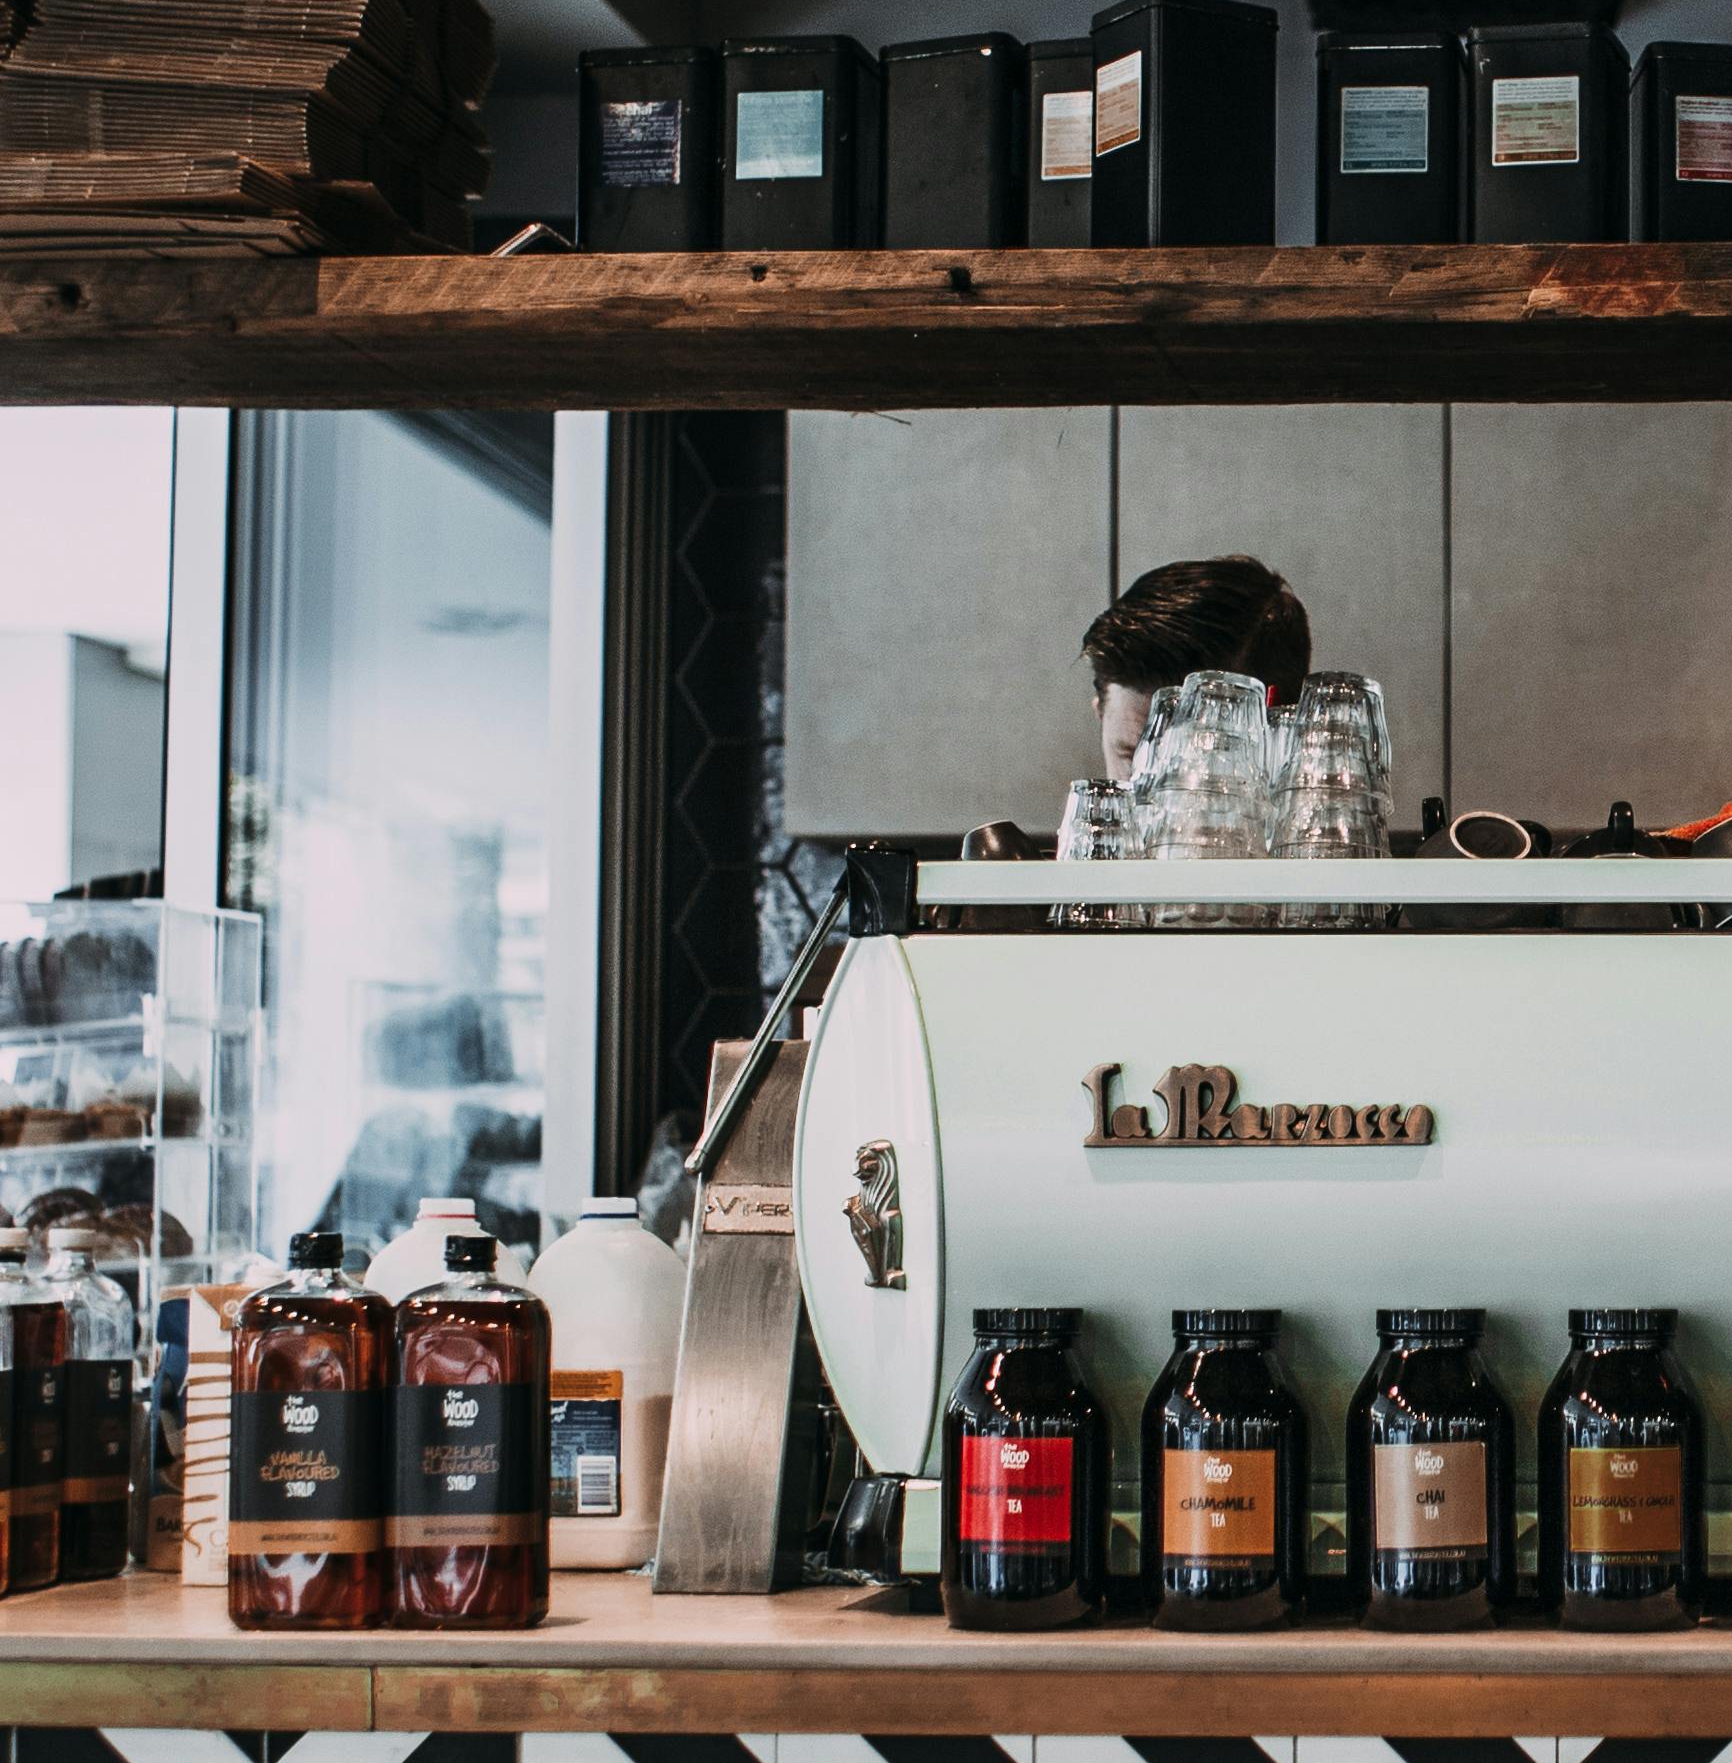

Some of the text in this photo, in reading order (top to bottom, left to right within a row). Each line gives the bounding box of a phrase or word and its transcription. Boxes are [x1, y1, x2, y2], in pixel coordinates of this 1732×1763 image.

[1081, 1063, 1434, 1141] La Marzocco
[282, 1405, 319, 1425] WOOD
[443, 1399, 479, 1419] WOOD
[270, 1450, 327, 1466] VANILLA
[424, 1444, 497, 1460] HAZELNUT
[1001, 1449, 1030, 1464] WOOD
[1415, 1455, 1445, 1470] WOOD
[1610, 1460, 1639, 1475] WOOD
[1203, 1463, 1233, 1478] WOOD
[285, 1481, 316, 1498] SYRUP
[447, 1474, 477, 1492] SYRUP
[1416, 1490, 1446, 1504] CHAI
[1007, 1499, 1022, 1514] TEA
[1424, 1505, 1440, 1520] TEA
[1210, 1513, 1226, 1528] TEA
